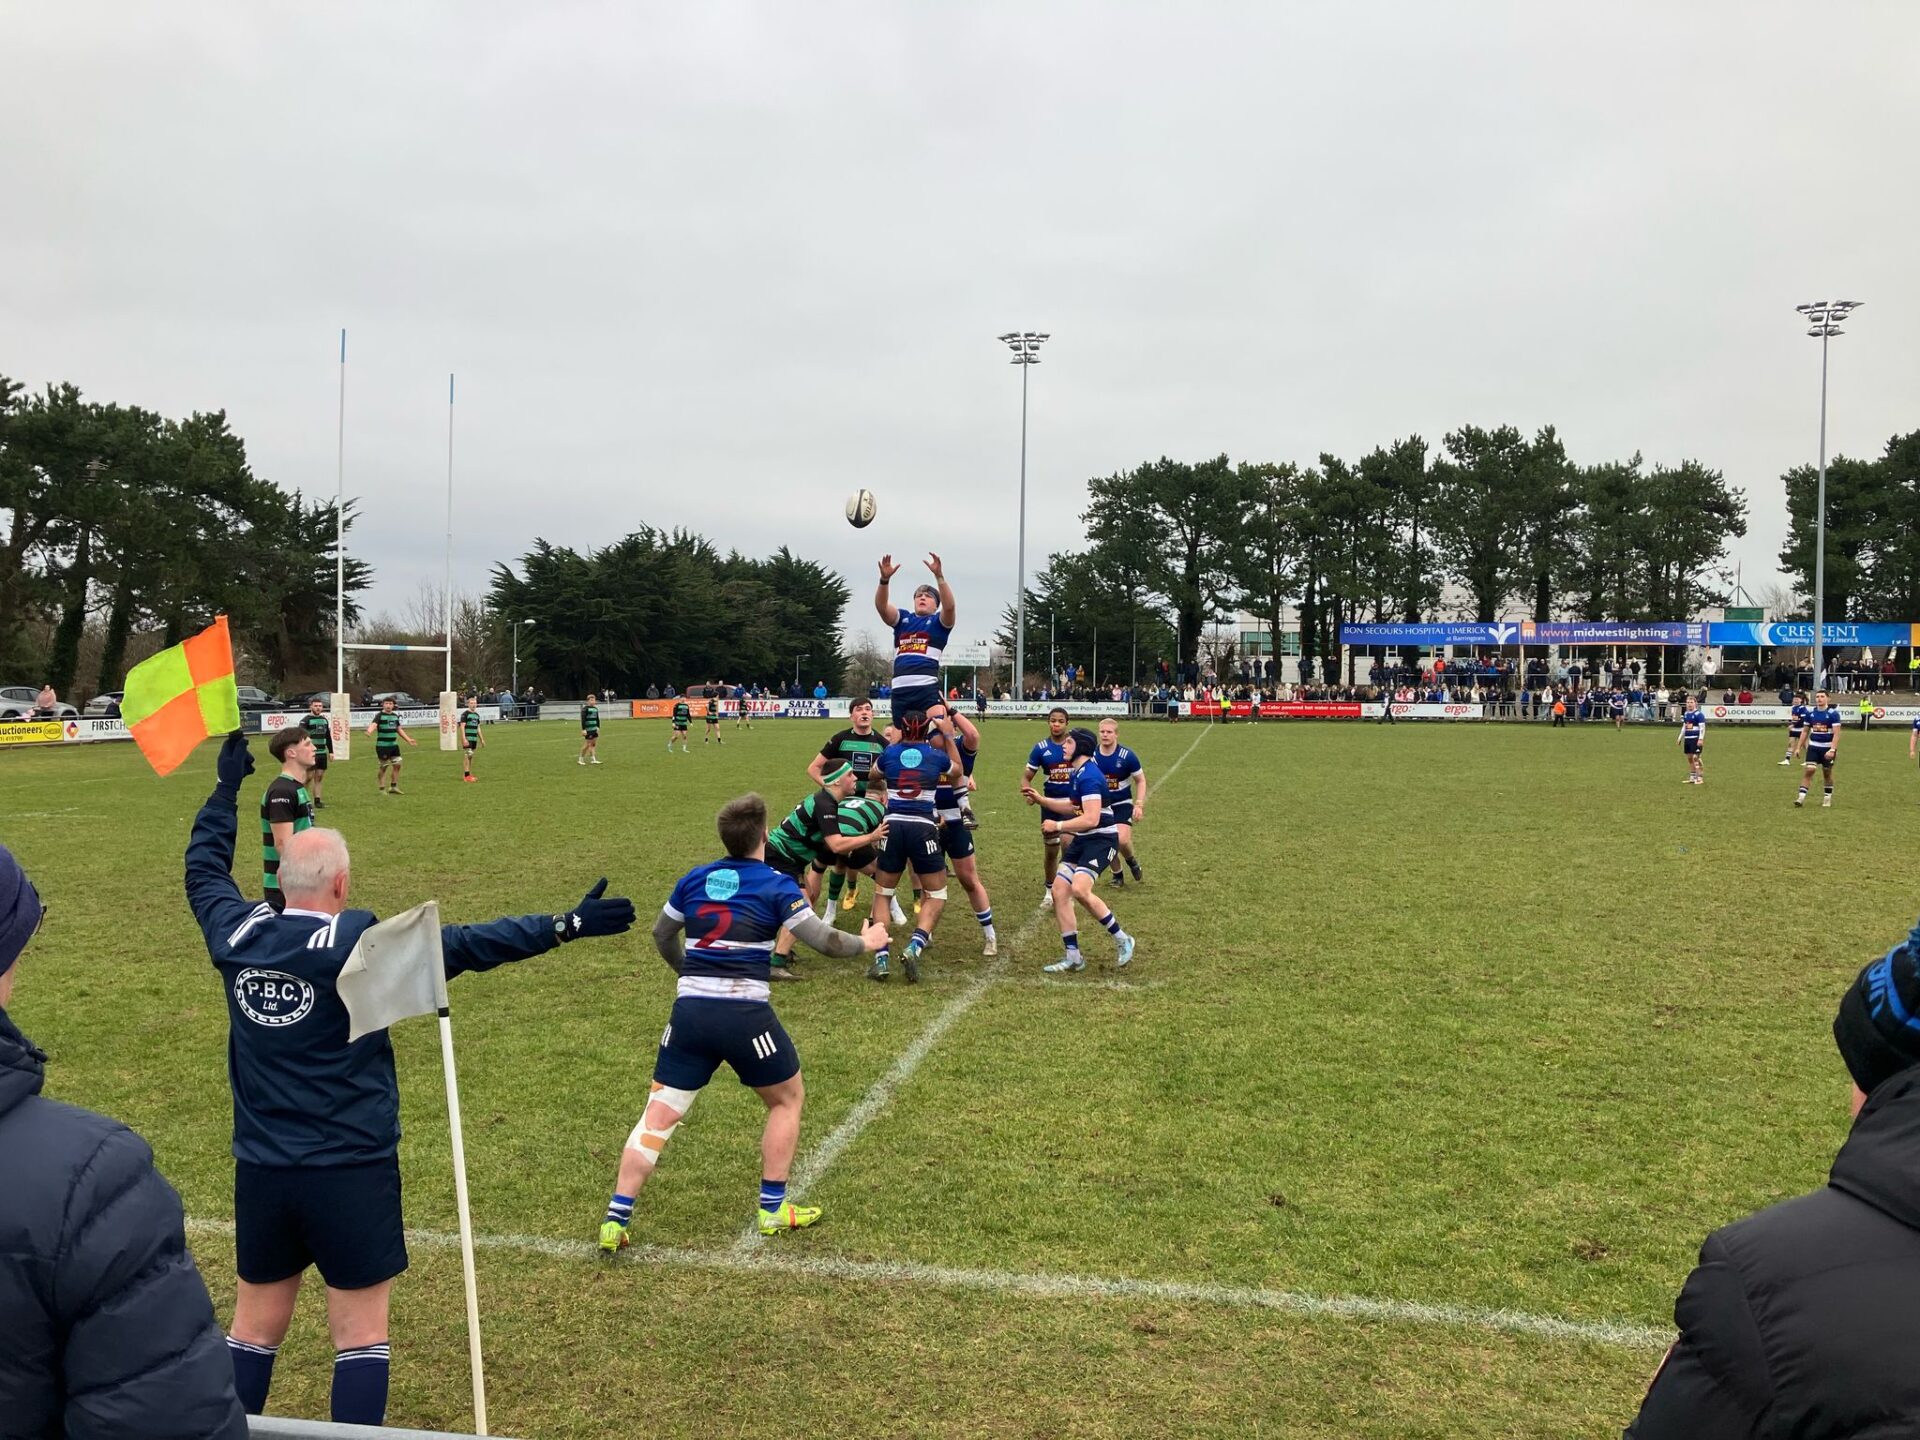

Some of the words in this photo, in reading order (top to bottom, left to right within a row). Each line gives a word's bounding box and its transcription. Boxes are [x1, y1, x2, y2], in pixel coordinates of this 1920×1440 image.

[1344, 626, 1363, 634] BON
[1365, 627, 1403, 635] SECOURS
[1405, 627, 1446, 635] HOSPITAL
[1447, 626, 1486, 634] LIMERICK
[1776, 625, 1860, 637] CRESCENT
[788, 700, 814, 708] SALT
[1391, 704, 1409, 715] rgo
[403, 710, 438, 719] BROOKFIELD
[788, 709, 821, 717] STEEL
[0, 725, 42, 735] uctioneers
[896, 769, 922, 800] 5
[708, 877, 739, 890] DOUGH
[694, 903, 734, 951] 2
[246, 981, 299, 1002] P.B.C.
[262, 1000, 279, 1011] Ltd.
